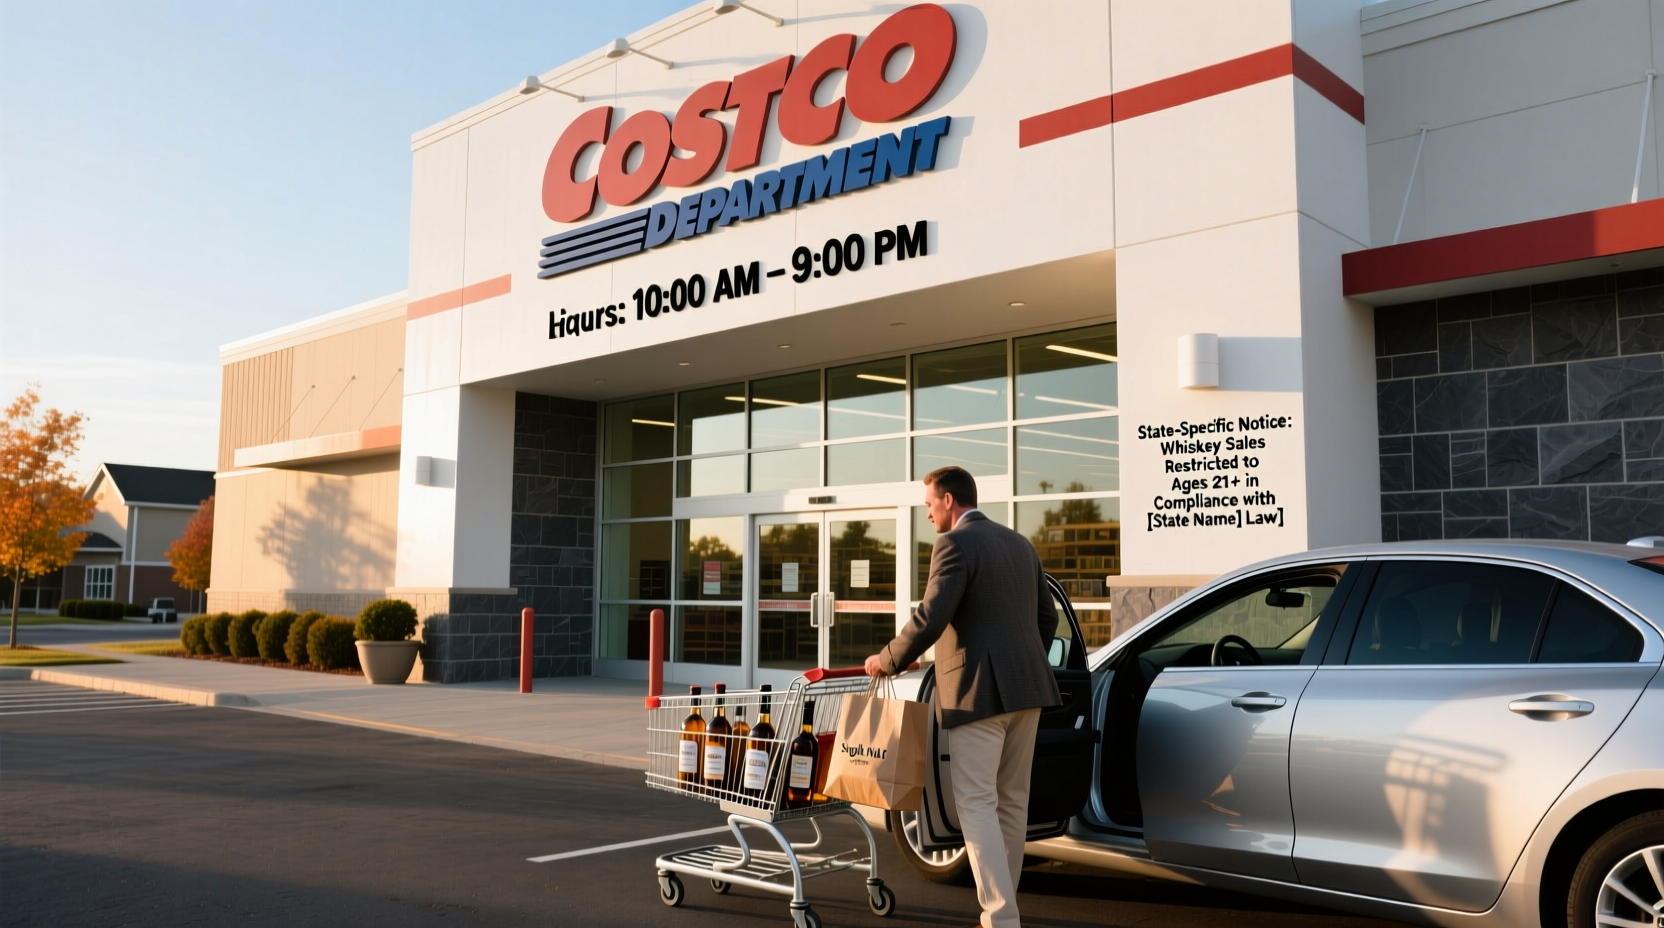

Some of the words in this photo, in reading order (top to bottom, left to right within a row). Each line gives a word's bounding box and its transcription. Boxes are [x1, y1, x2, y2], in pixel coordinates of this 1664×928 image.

[541, 3, 958, 224] COSTCO
[643, 115, 952, 250] DEPARTMENT
[632, 273, 706, 321] 10:00
[712, 260, 760, 303] AM
[791, 234, 865, 284] 9:00
[874, 220, 928, 266] PM
[1238, 414, 1292, 432] Notice:
[1160, 440, 1222, 456] Whiskey
[1225, 435, 1266, 451] Sales
[1165, 455, 1239, 474] Restricted
[1242, 456, 1260, 469] to
[1171, 477, 1209, 495] Ages
[1212, 475, 1241, 489] 21+
[1245, 473, 1259, 488] in
[1242, 490, 1276, 506] with
[1147, 512, 1190, 532] [State
[1193, 509, 1242, 529] Name]
[1246, 507, 1284, 528] Law]
